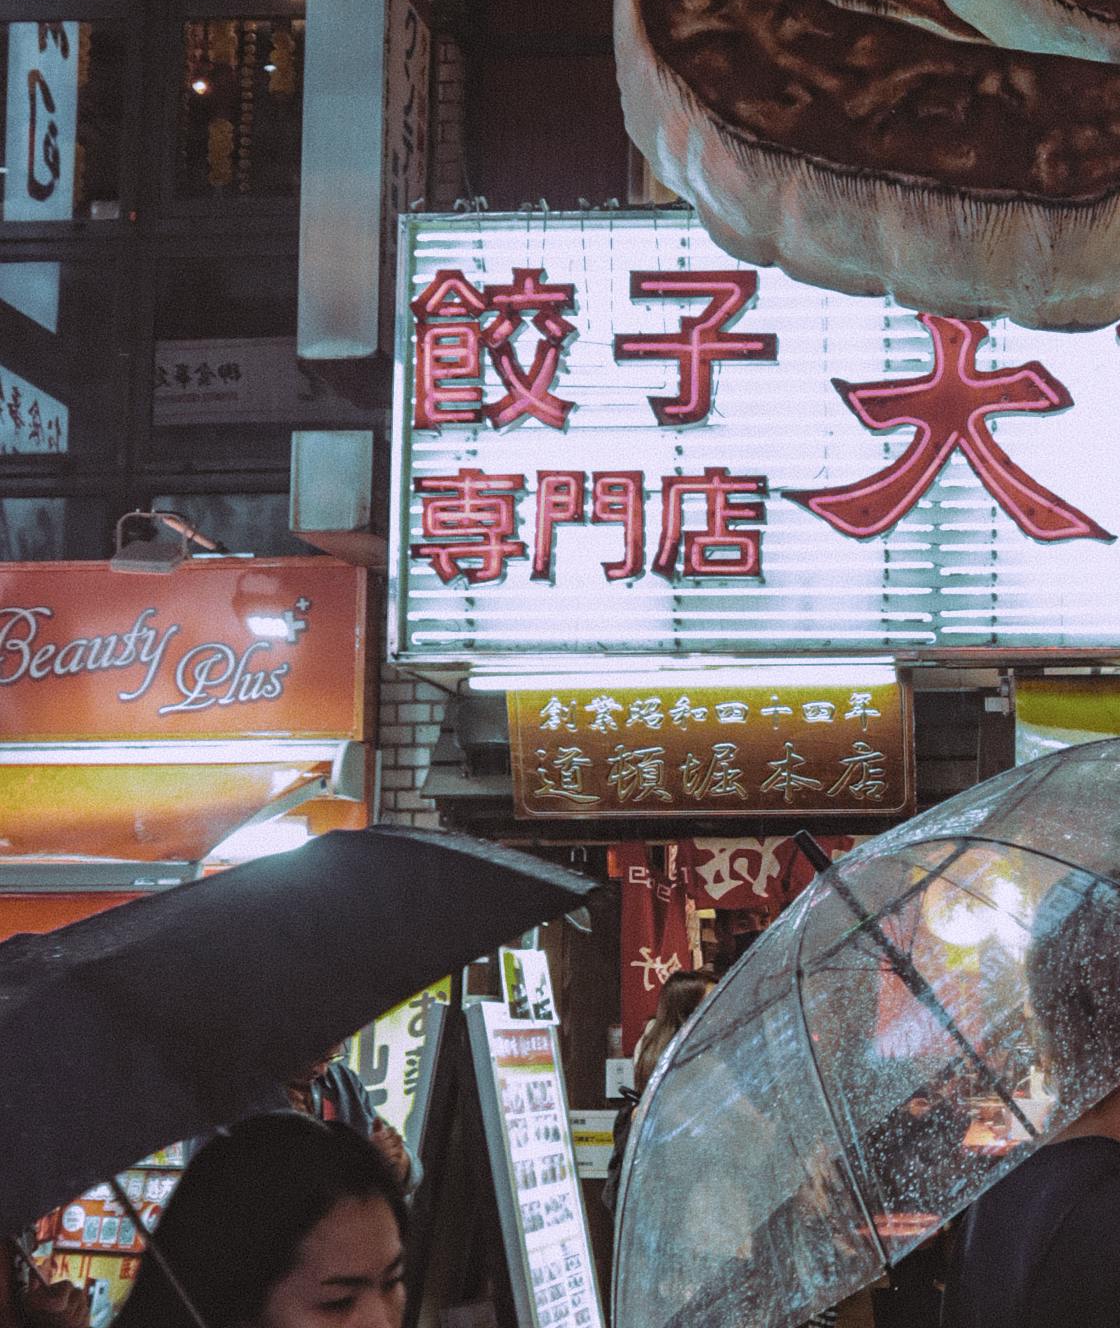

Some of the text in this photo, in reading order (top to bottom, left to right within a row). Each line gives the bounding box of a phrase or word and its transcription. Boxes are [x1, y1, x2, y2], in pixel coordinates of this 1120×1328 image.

[410, 268, 778, 434] 餃子
[410, 468, 768, 586] 専門店
[0, 607, 289, 715] Beauty Plus
[539, 692, 882, 734] 創業昭和四十四年
[534, 742, 890, 804] 道頓堀本店
